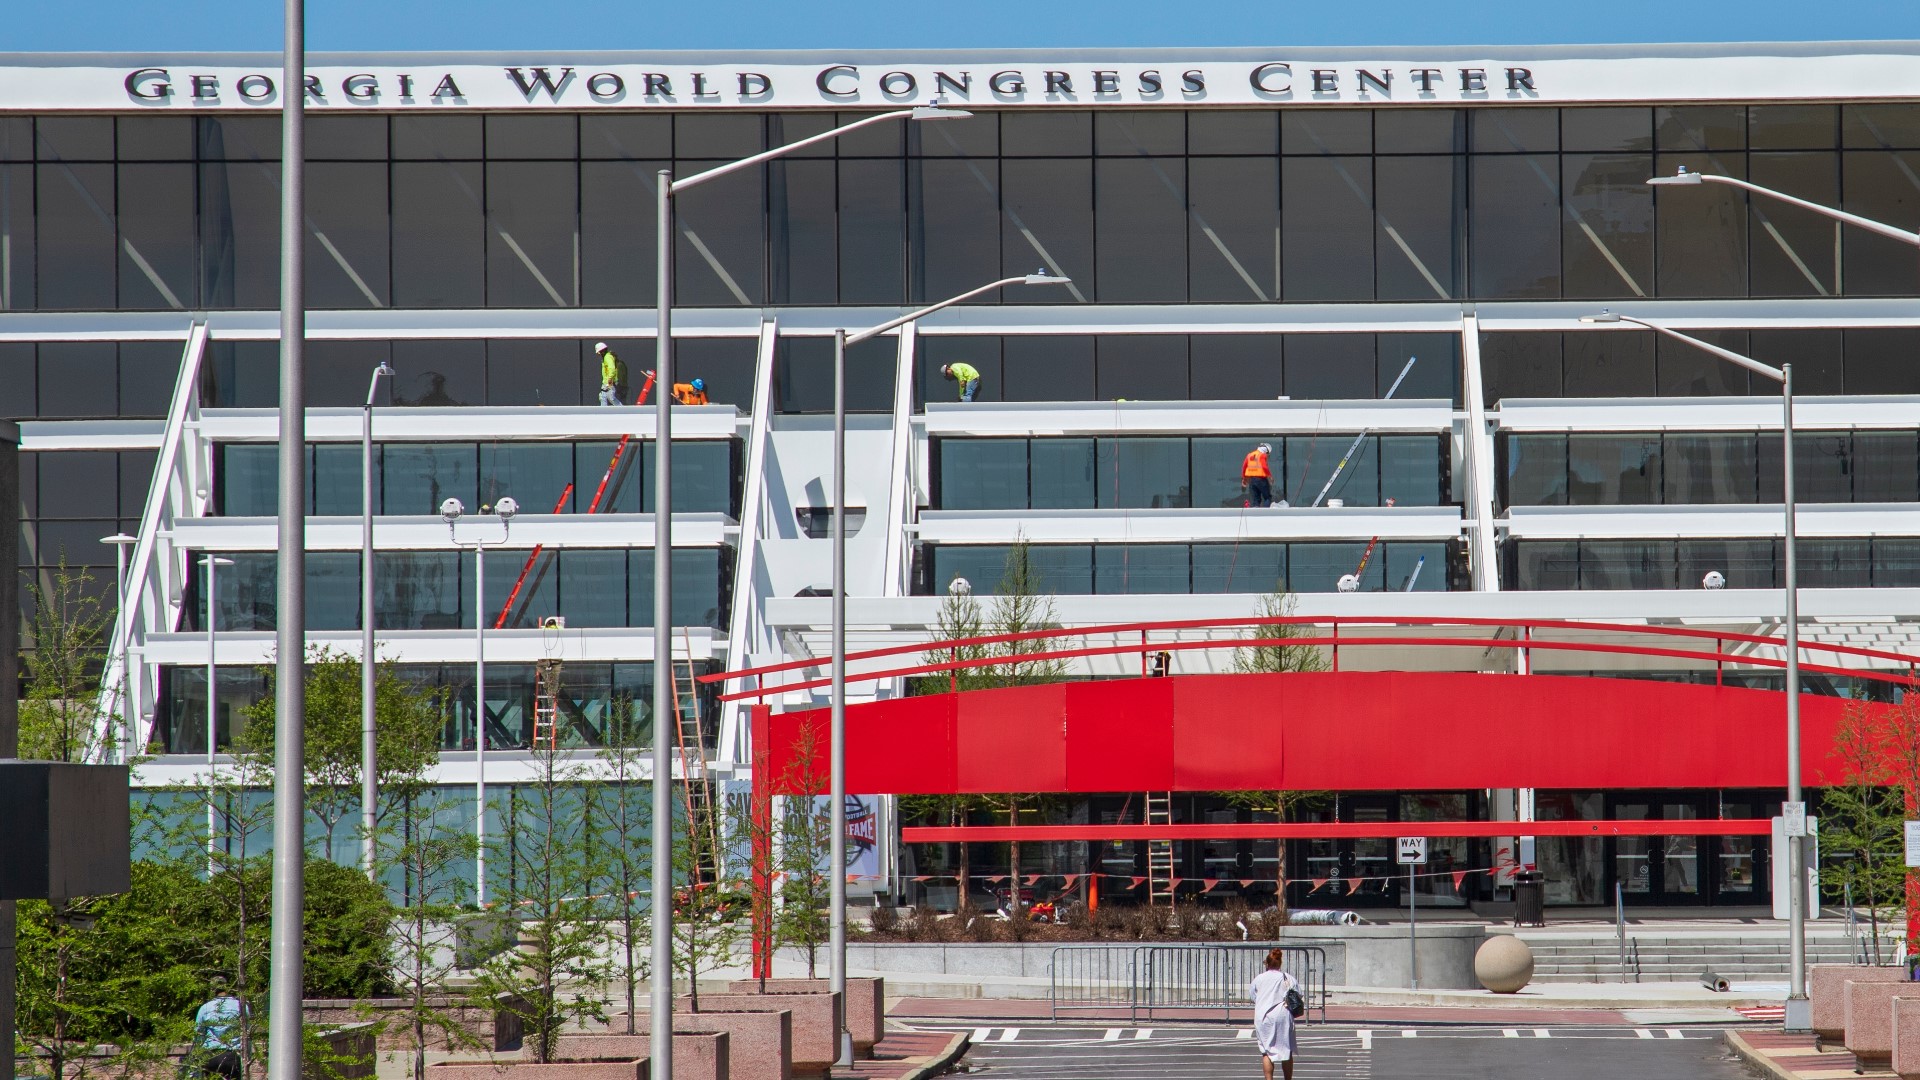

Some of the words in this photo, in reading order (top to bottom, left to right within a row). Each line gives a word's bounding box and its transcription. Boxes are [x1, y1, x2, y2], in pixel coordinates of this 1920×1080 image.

[126, 67, 466, 101] GEORGIA
[507, 66, 773, 98] WORLD
[815, 64, 1207, 97] CONGRESS
[1249, 61, 1537, 95] CENTER
[848, 817, 874, 841] FAME
[1400, 838, 1422, 848] WAY
